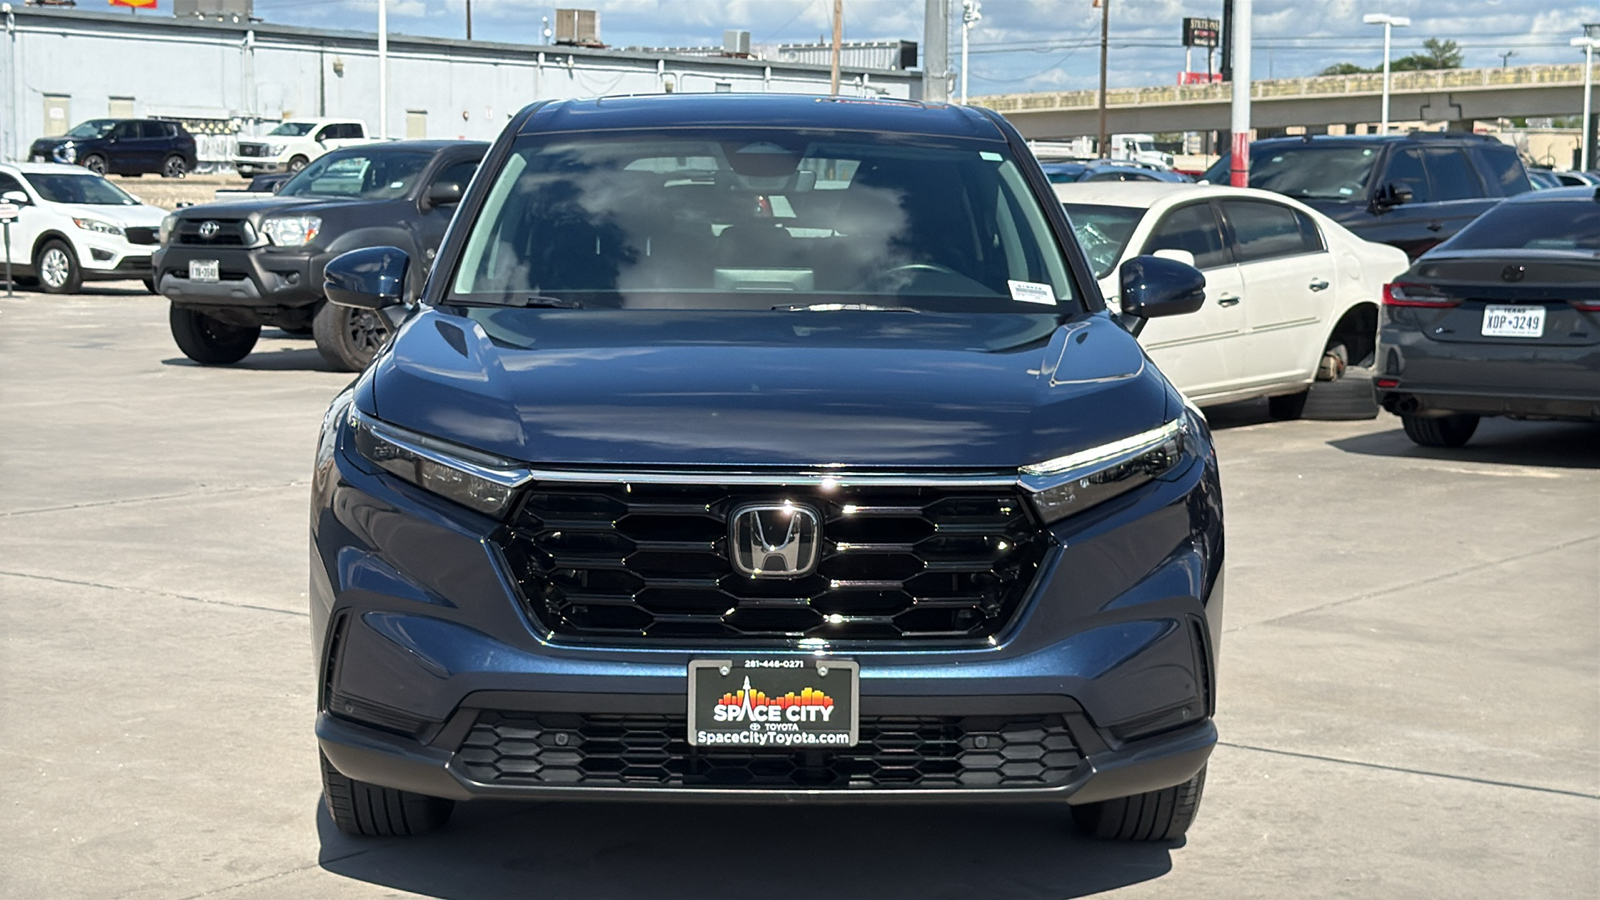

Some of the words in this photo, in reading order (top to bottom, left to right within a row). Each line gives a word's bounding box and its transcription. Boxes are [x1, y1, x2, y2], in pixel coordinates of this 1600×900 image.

[1512, 316, 1540, 331] 3249
[745, 660, 804, 668] 281-446-0271
[714, 704, 782, 722] SPACE
[786, 705, 834, 722] CITY
[765, 723, 799, 731] TOYOTA
[698, 731, 849, 745] SpaceCityToyota.com
